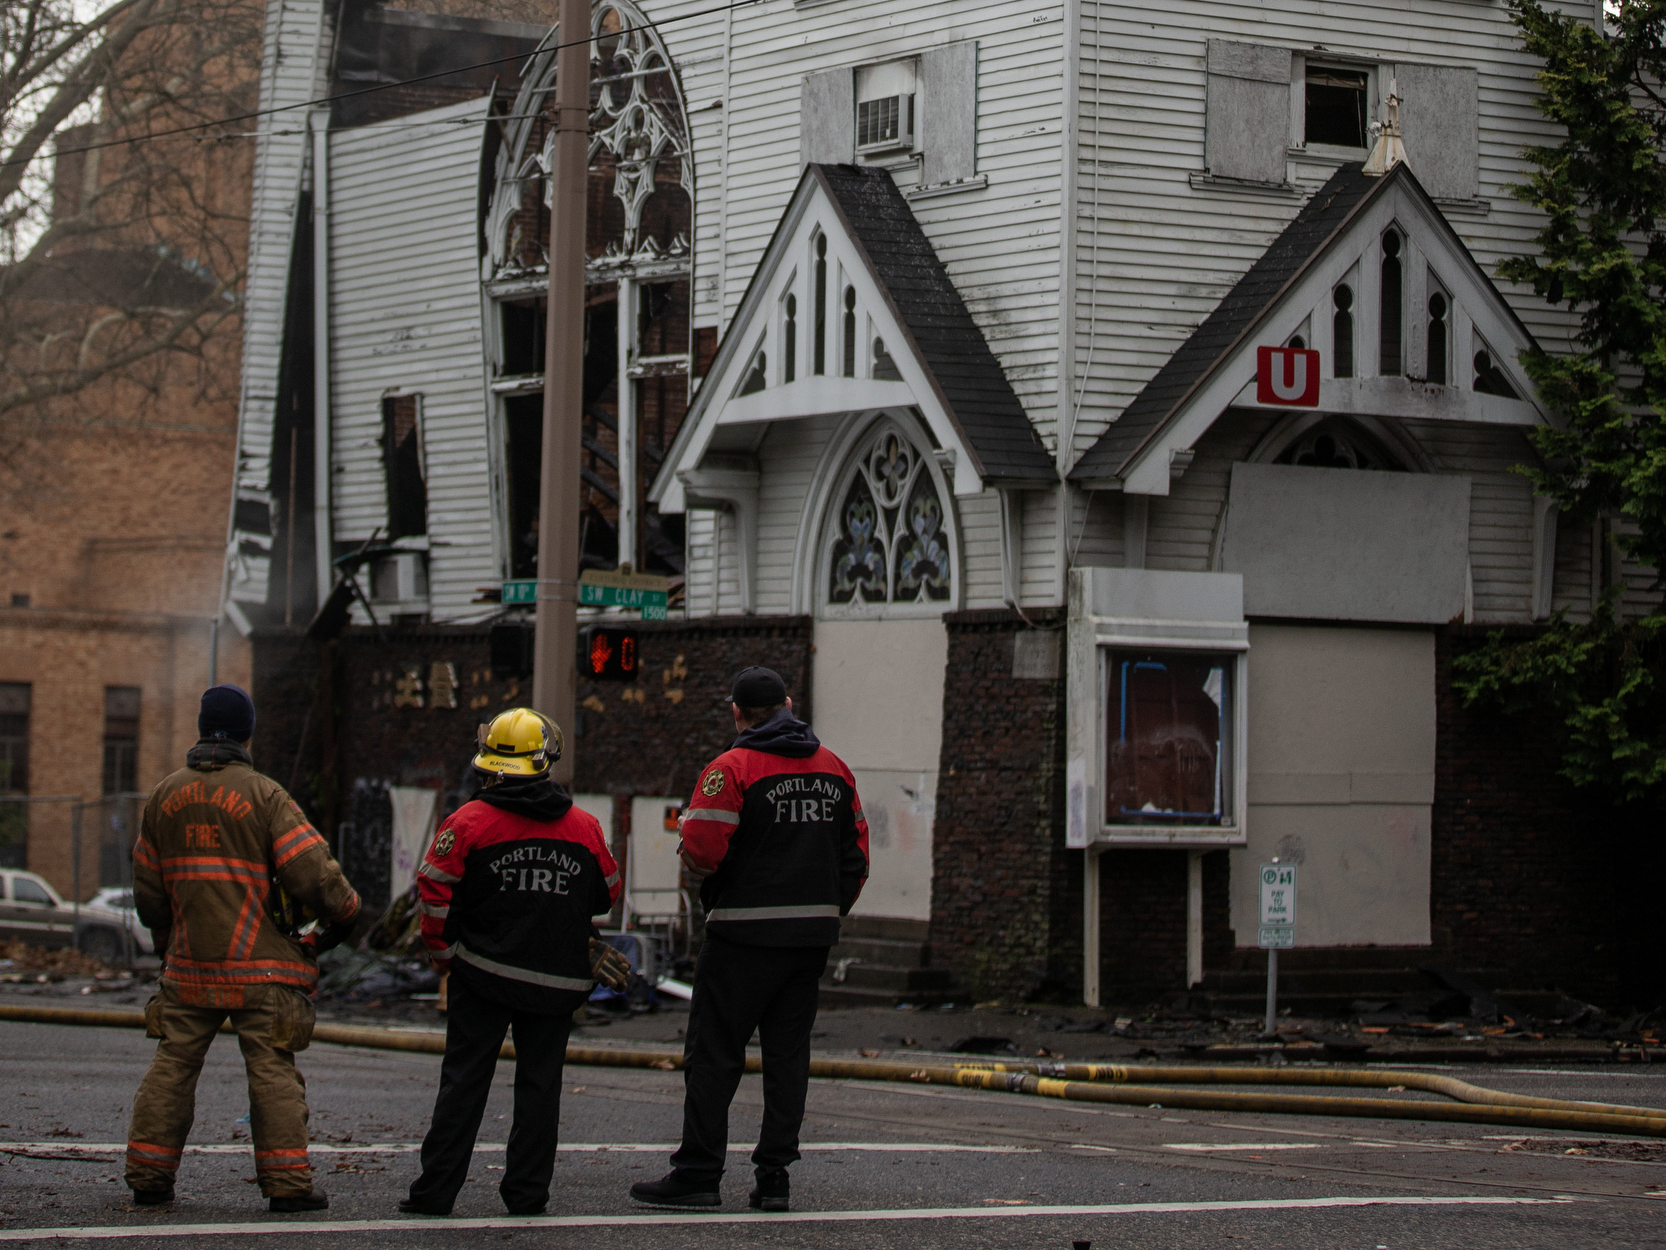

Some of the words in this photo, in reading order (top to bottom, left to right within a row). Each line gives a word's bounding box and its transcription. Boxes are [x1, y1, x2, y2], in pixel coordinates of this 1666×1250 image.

[1271, 352, 1307, 401] U
[587, 586, 604, 601] SW
[615, 588, 644, 604] CLAY
[643, 606, 666, 620] 1500
[489, 760, 521, 771] BLACKWOOD
[160, 780, 252, 821] PORTLAND
[766, 778, 841, 804] PORTLAND
[774, 799, 836, 823] FIRE
[185, 824, 221, 849] FIRE
[489, 846, 581, 876] PORTLAND
[500, 868, 571, 895] FIRE
[1271, 890, 1285, 898] PAY
[1273, 898, 1283, 906] TO
[1268, 906, 1288, 914] PARK
